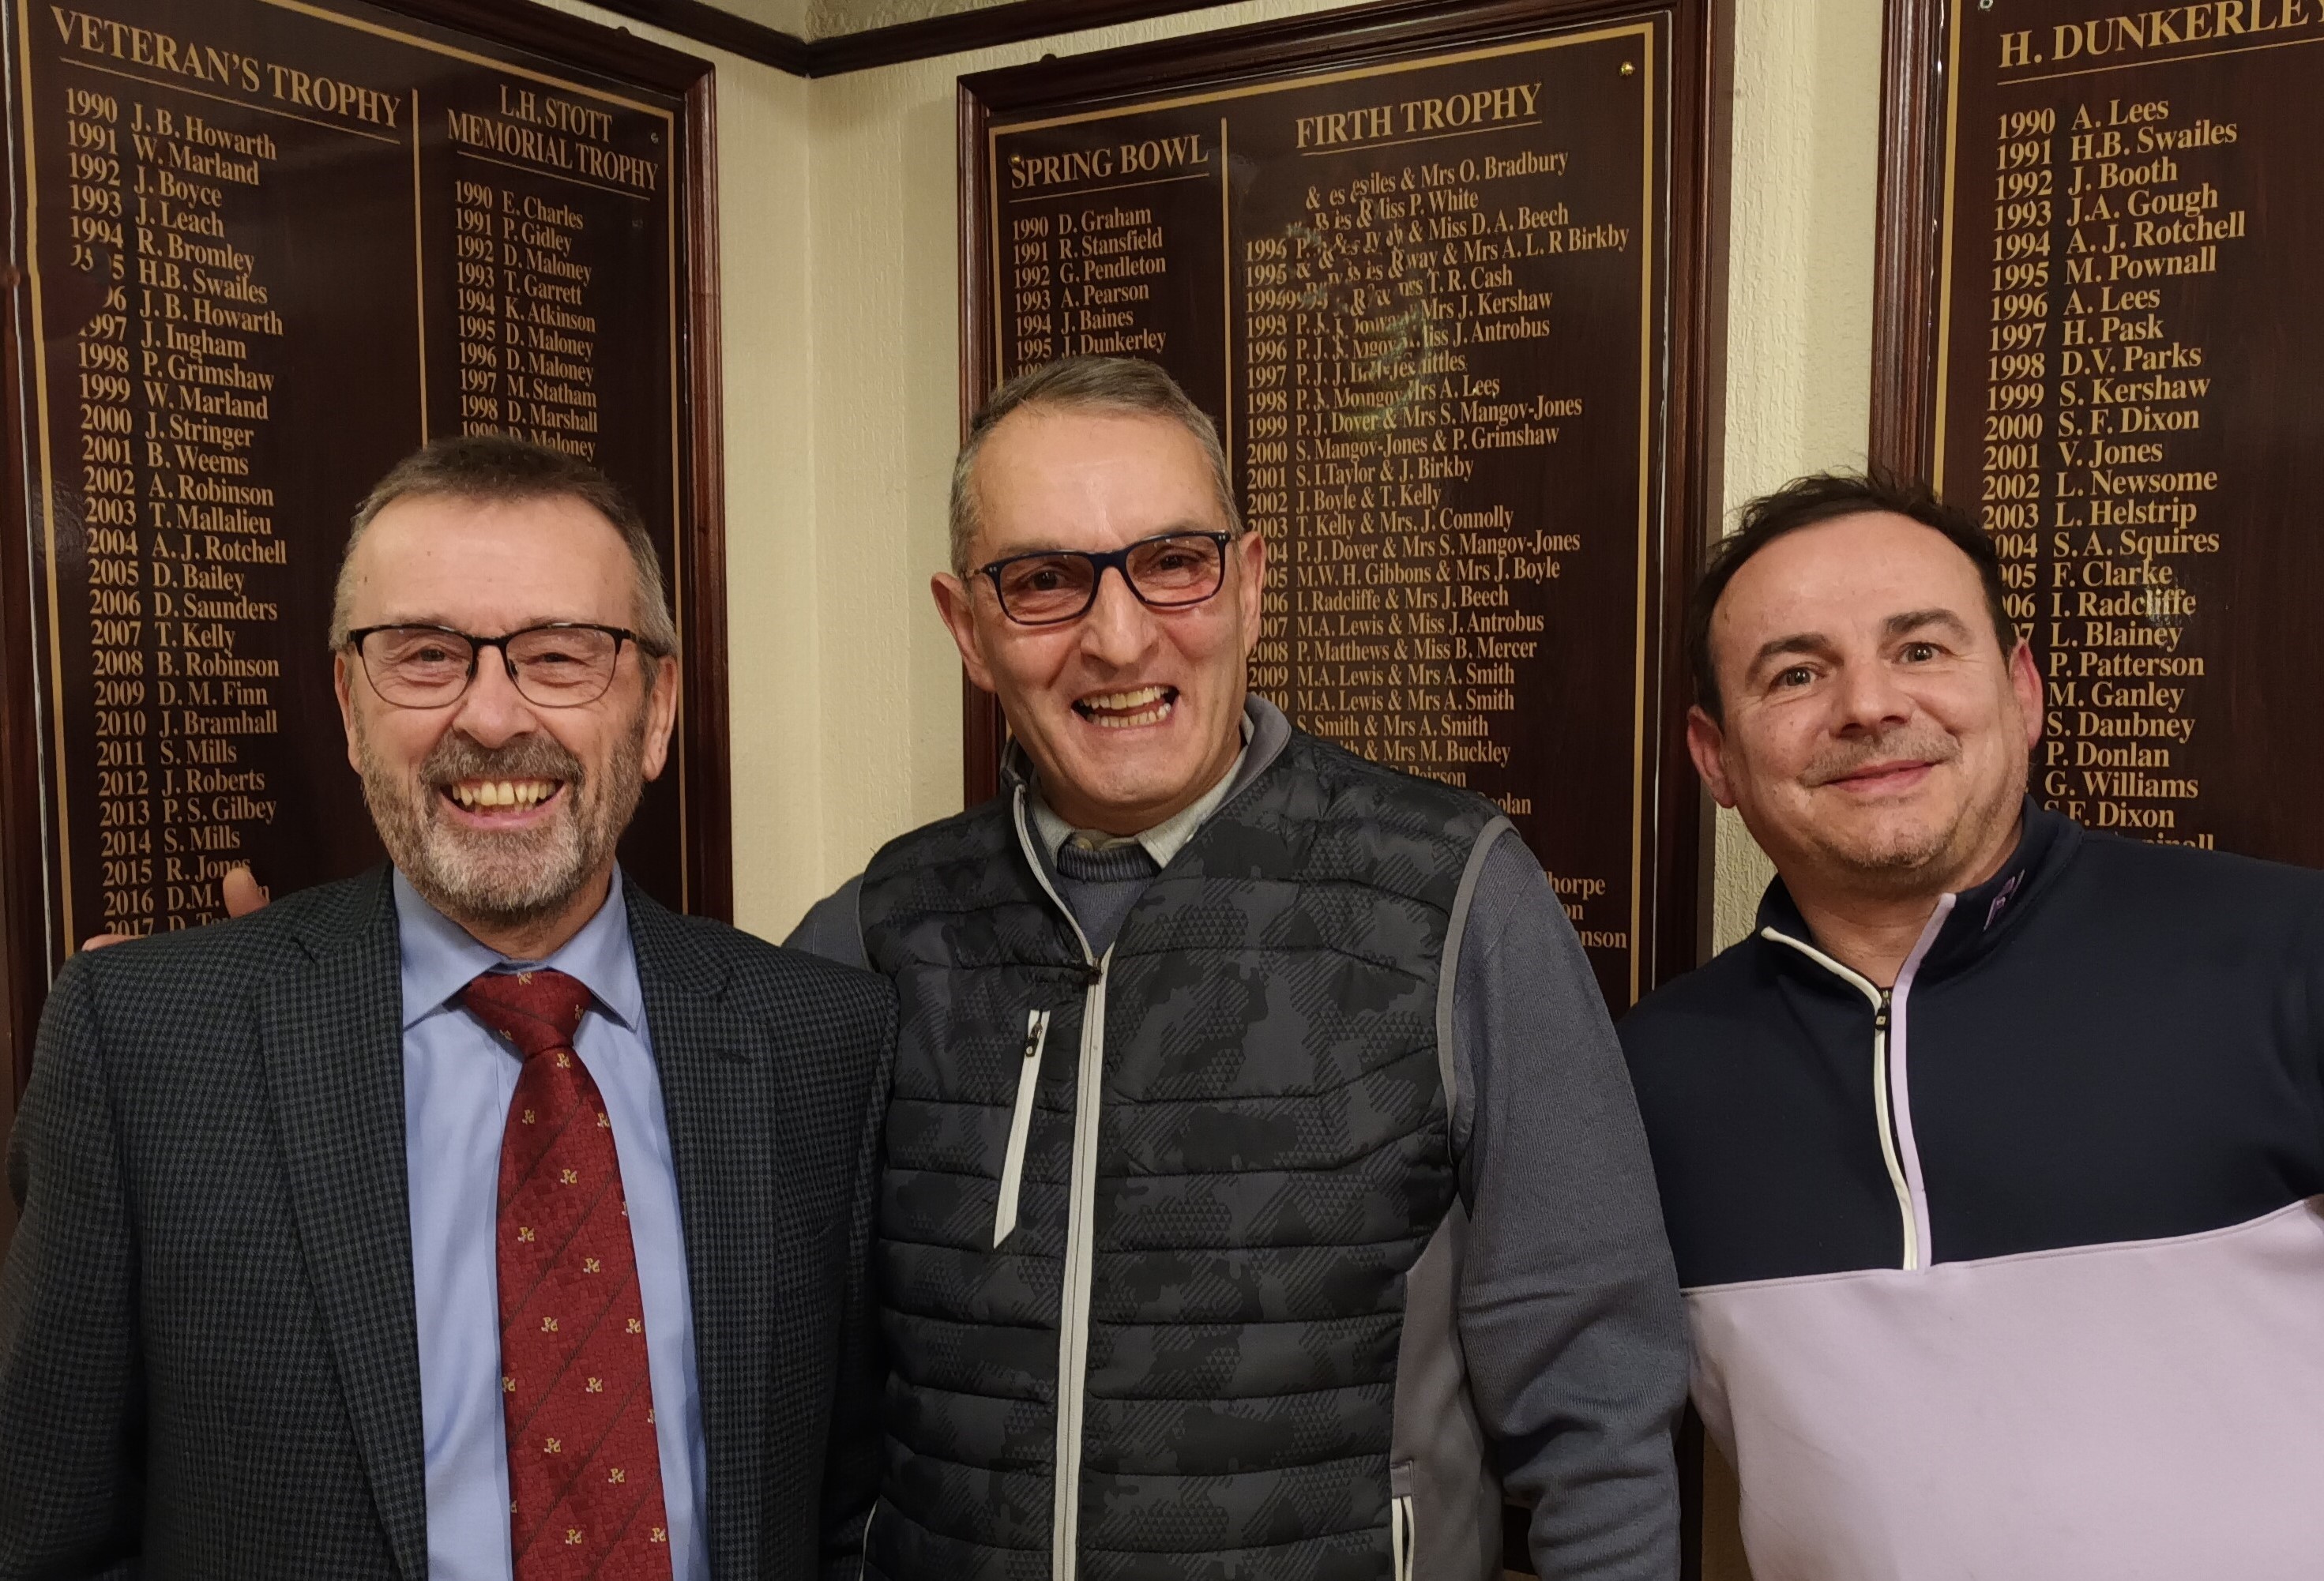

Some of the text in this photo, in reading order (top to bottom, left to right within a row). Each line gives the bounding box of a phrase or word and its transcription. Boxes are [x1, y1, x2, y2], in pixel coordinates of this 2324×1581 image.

[51, 6, 400, 129] VETERAN'S TROPHY
[1999, 30, 2042, 68] H.
[545, 98, 612, 144] STOTT
[1295, 84, 1542, 150] FIRTH TROPHY
[1999, 100, 2168, 139] 1990 A. Lees
[68, 120, 261, 187] 1991 W. Marland
[448, 107, 658, 193] MEMORIAL TROPHY
[1011, 134, 1209, 188] SPRING BOWL
[70, 152, 221, 210] 1992 J. Boyce
[1995, 156, 2177, 201] 1992 J. Booth
[71, 182, 224, 240] 1993 J. Leach
[456, 180, 583, 231] 1990 E. Charles
[1014, 207, 1152, 240] 1990 D. Graham
[457, 208, 571, 259] 1991 P. Gidley
[1014, 225, 1162, 265] 1991 R. Stansfield
[457, 235, 591, 288] 1992 D. Maloney
[1015, 256, 1166, 289] 1992 G. Pendleton
[1992, 244, 2216, 291] 1995 M. Pownall
[458, 288, 595, 335] 1994 K. Atkinson
[1016, 284, 1149, 313] 1993 A. Pearson
[1991, 287, 2160, 321] 1996 A. Lees
[460, 315, 594, 363] 1995 D. Maloney
[1017, 308, 1134, 336] 1994 J. Baines
[1990, 314, 2163, 351] 1997 H. Pask
[78, 342, 273, 393] 1998 P. Grimshaw
[79, 373, 268, 422] 1999 W. Marland
[461, 368, 596, 407] 1997 M. Statham
[1987, 374, 2210, 411] 1999 S. Kershaw
[81, 404, 255, 453] 2000 J. Stringer
[461, 395, 597, 434] 1998 D. Marshall
[1249, 395, 1581, 439] 1999 P. J. Dover & Mrs S. Mangov-Jones
[1247, 423, 1559, 467] 2000 S. Mangov-Jones & P. Grimshaw
[1983, 440, 2162, 470] 2001 V. Jones
[84, 466, 273, 506] 2002 A. Robinson
[1247, 483, 1441, 518] 2002 J. Boyle & T. Kelly
[1982, 470, 2217, 500] 2002 L. Newsome
[85, 496, 271, 534] 2003 T. Mallalieu
[1982, 497, 2196, 529] 2003 L. Helstrip
[88, 558, 244, 596] 2005 D. Bailey
[90, 589, 277, 620] 2006 D. Saunders
[92, 650, 279, 677] 2008 B. Robinson
[1249, 667, 1288, 687] 2009
[1340, 665, 1383, 685] Lewis
[1389, 664, 1401, 685] &
[1408, 663, 1443, 685] Mrs
[1444, 663, 1461, 685] A.
[1466, 663, 1514, 684] Smith
[2049, 652, 2204, 677] P. Patterson
[2048, 682, 2185, 713] M. Ganley
[96, 710, 277, 738] 2010 J. Bramhall
[2048, 712, 2194, 743] S. Daubney
[99, 768, 265, 797] 2012 J. Roberts
[2045, 771, 2198, 798] G. Williams
